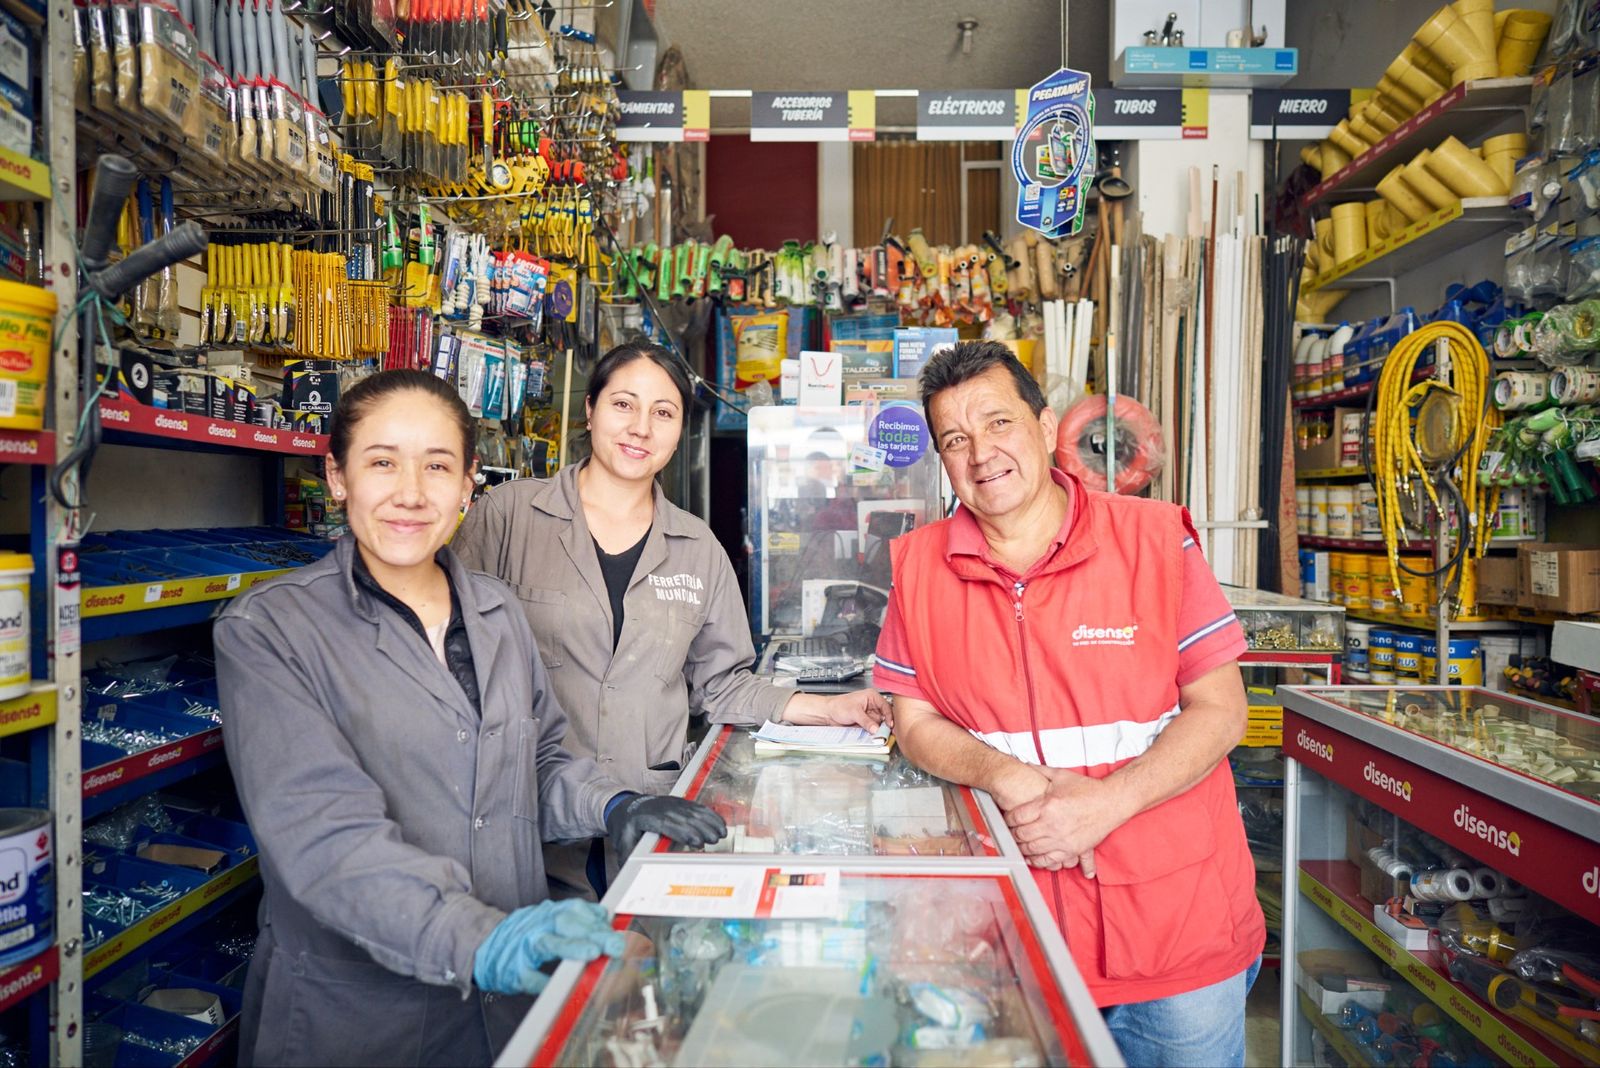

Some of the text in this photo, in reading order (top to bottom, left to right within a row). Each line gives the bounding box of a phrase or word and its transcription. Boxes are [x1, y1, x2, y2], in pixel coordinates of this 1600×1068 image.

[619, 102, 675, 115] RAMIENTAS
[772, 97, 832, 109] ACCESORIOS
[928, 96, 1006, 115] ELÉCTRICOS
[1114, 100, 1156, 114] TUBOS
[1279, 99, 1327, 114] HIERRO
[782, 107, 823, 122] TUBERÍA
[100, 407, 130, 422] sensa
[155, 414, 188, 431] disensa
[879, 421, 920, 431] Recibimos
[208, 423, 236, 438] disensa
[254, 430, 277, 444] disensa
[879, 430, 919, 443] todas
[292, 436, 316, 448] disensa
[890, 443, 919, 452] tarjetas
[85, 594, 125, 608] disensa
[655, 588, 701, 605] MUNDIAL
[1072, 624, 1134, 640] disensa
[1297, 729, 1333, 762] disensa
[148, 747, 182, 766] disensa
[84, 767, 124, 789] disensa
[1363, 761, 1412, 802] disensa
[1453, 804, 1521, 857] disensa
[1407, 963, 1436, 992] disensa
[1449, 994, 1482, 1028] disensa
[1497, 1034, 1536, 1068] disensa
